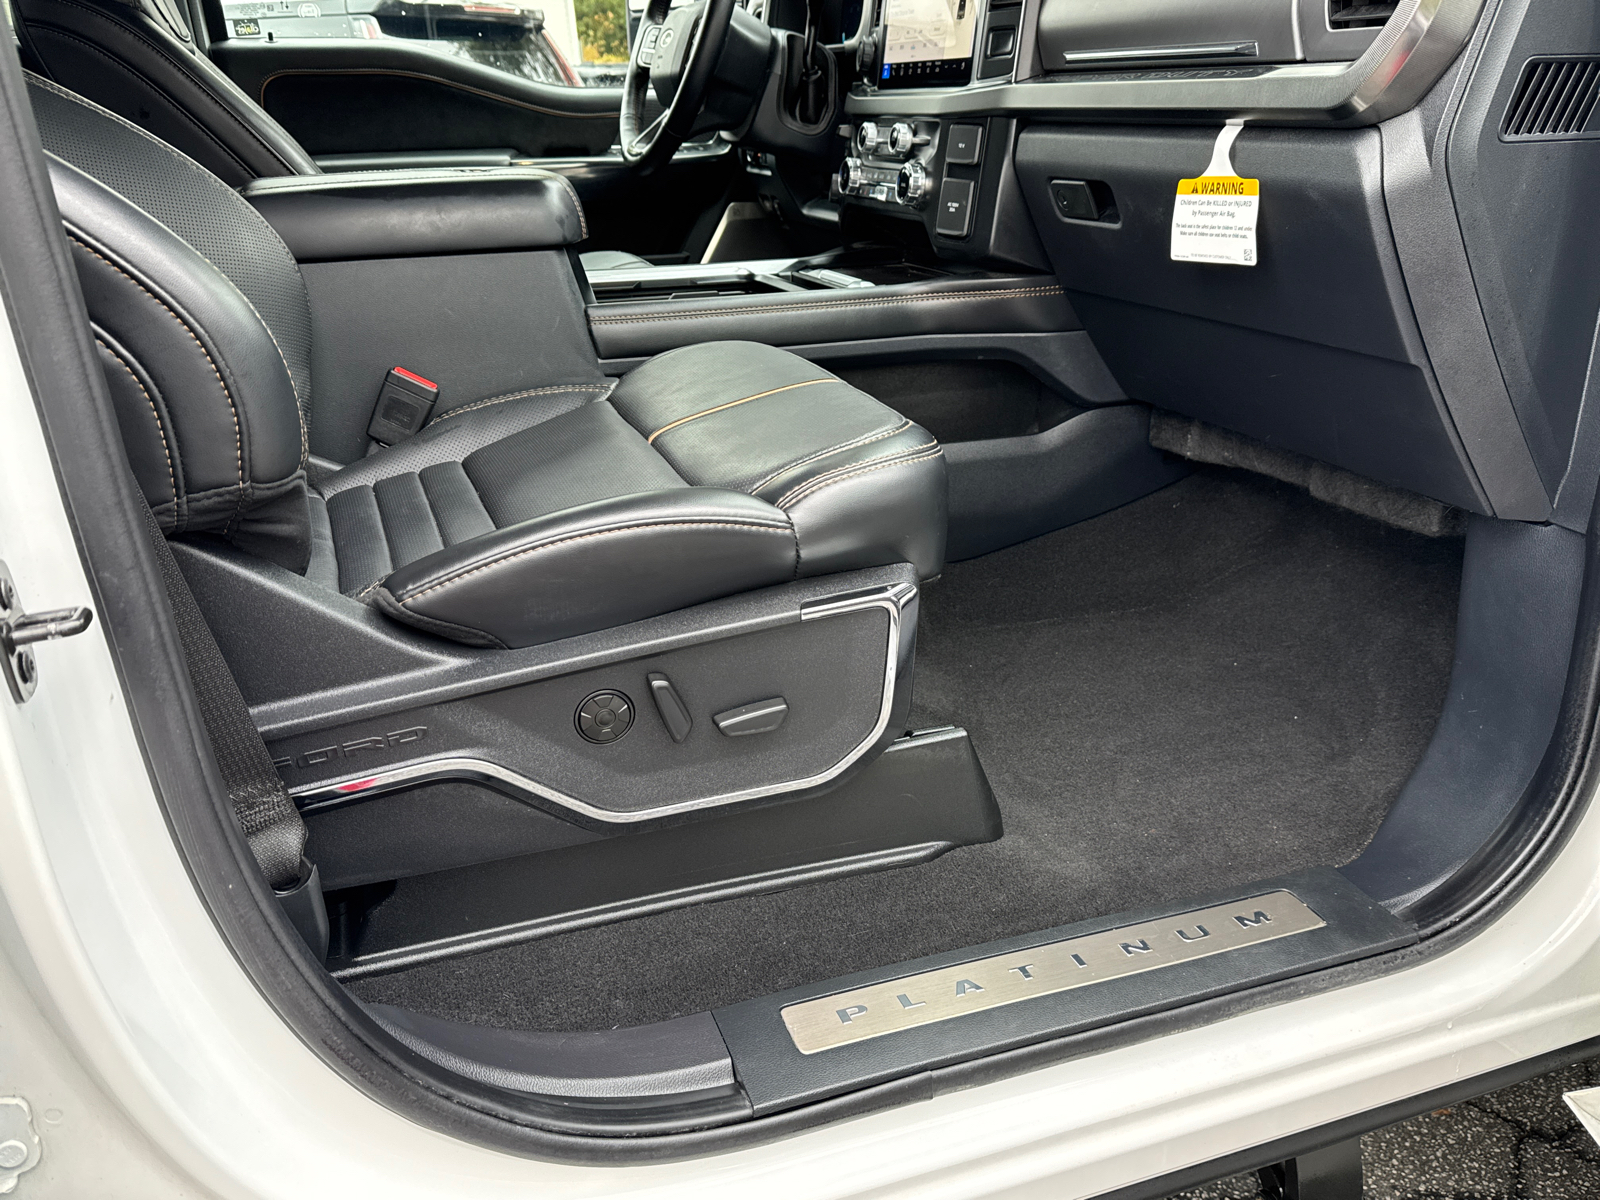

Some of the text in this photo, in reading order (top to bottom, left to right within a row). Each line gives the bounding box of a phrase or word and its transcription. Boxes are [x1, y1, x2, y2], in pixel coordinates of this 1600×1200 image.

[1201, 182, 1244, 195] WARNING
[1233, 200, 1252, 208] INJURED
[1192, 209, 1197, 217] by
[1198, 210, 1219, 218] Passenger
[273, 726, 428, 767] ORD
[835, 908, 1272, 1024] PLATINUM
